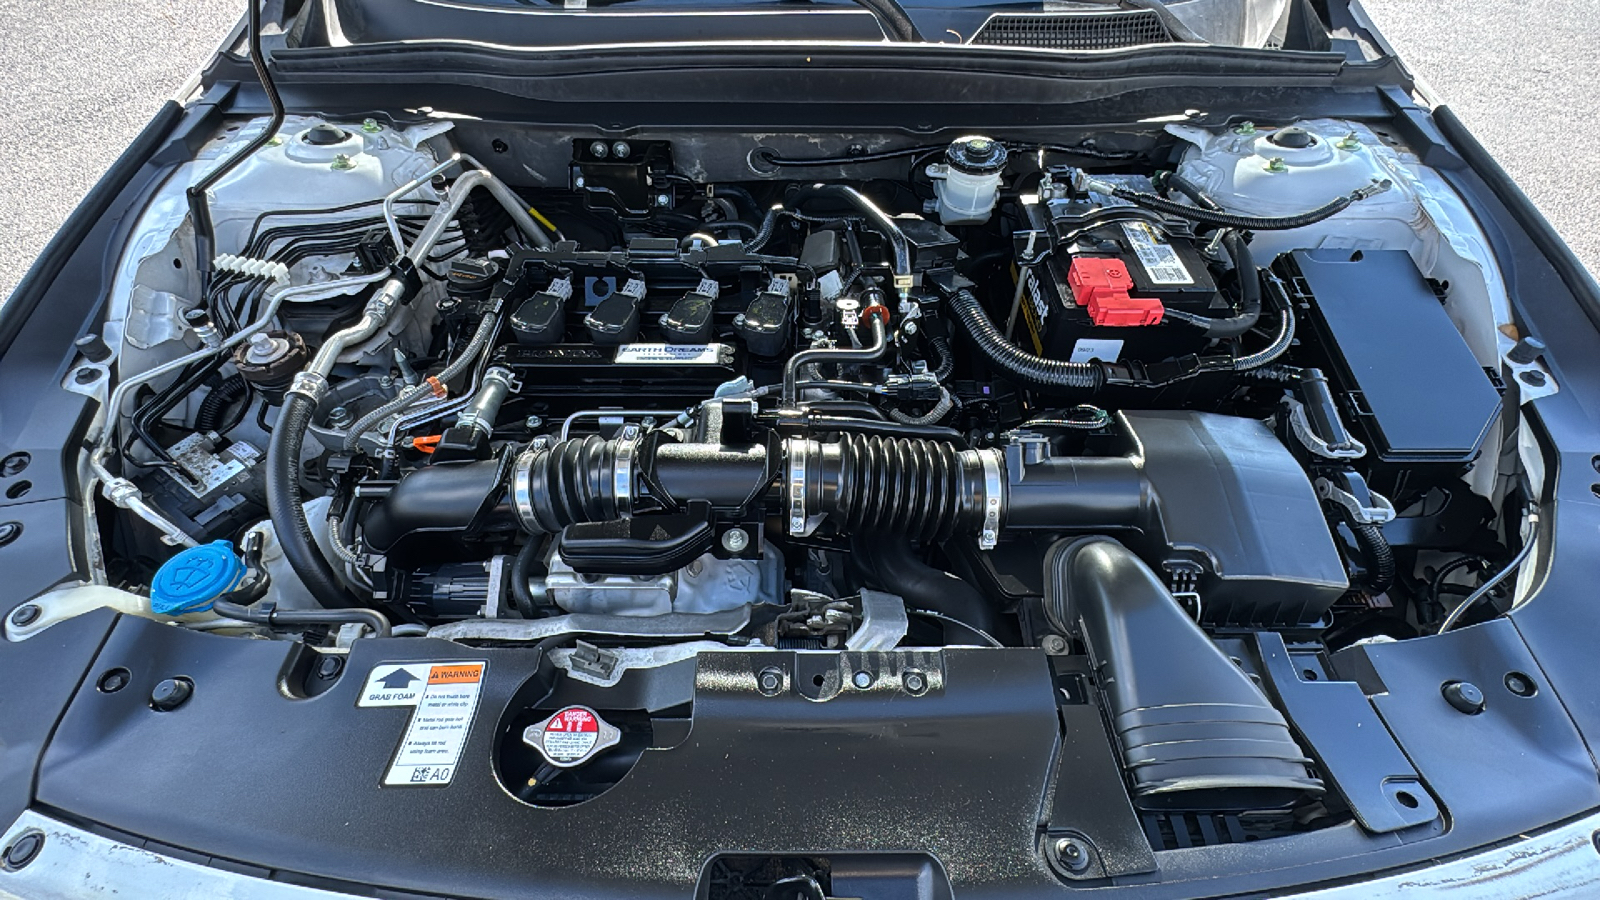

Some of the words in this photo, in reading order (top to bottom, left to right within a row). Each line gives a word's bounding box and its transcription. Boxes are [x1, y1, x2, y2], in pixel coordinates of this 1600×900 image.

[516, 349, 602, 358] HONDA
[441, 670, 479, 679] WARNING
[369, 693, 391, 701] GRAB
[392, 692, 416, 700] FOAM
